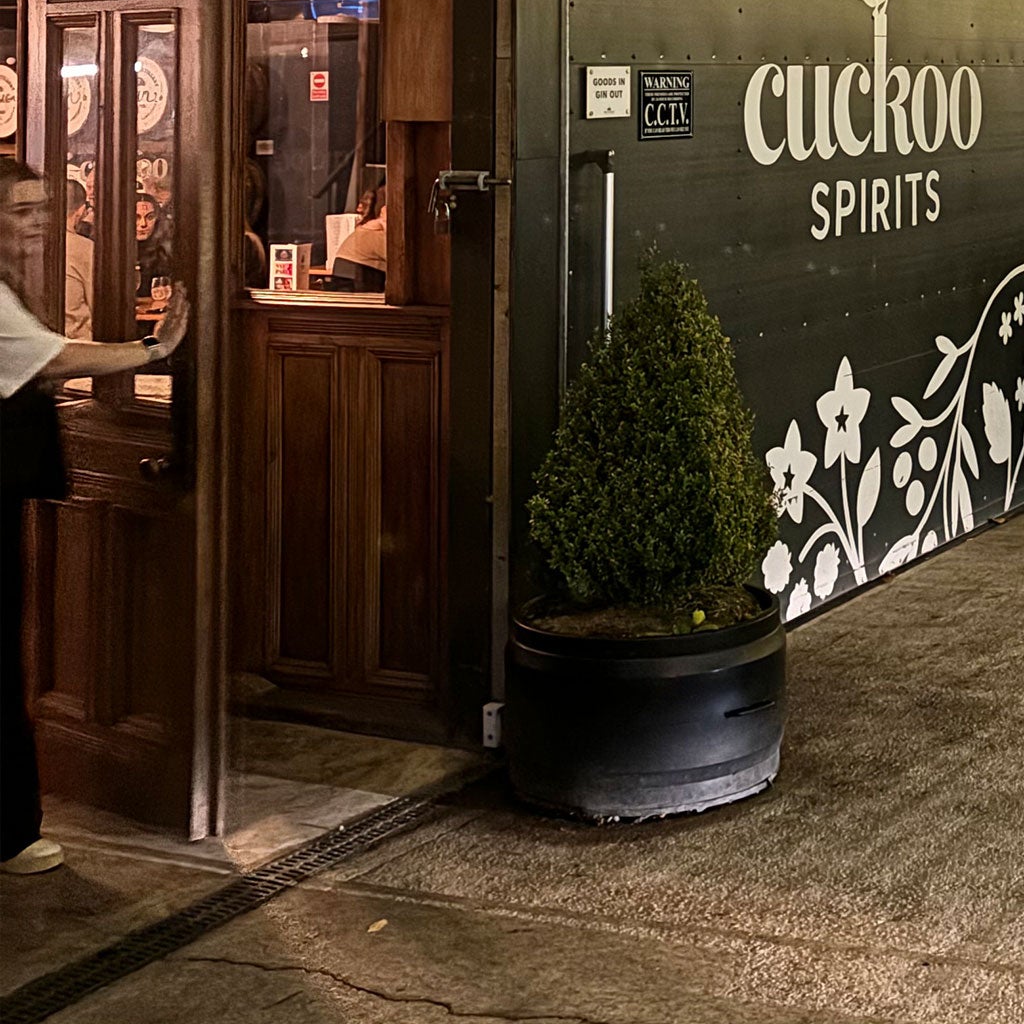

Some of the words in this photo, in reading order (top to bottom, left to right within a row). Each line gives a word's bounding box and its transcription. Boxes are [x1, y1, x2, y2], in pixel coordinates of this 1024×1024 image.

[593, 78, 617, 86] GOODS
[619, 77, 626, 86] IN
[644, 76, 690, 89] WARNING
[595, 90, 608, 99] GIN
[609, 90, 623, 98] OUT
[644, 102, 690, 127] C.C.T.V.
[810, 170, 941, 240] SPIRITS
